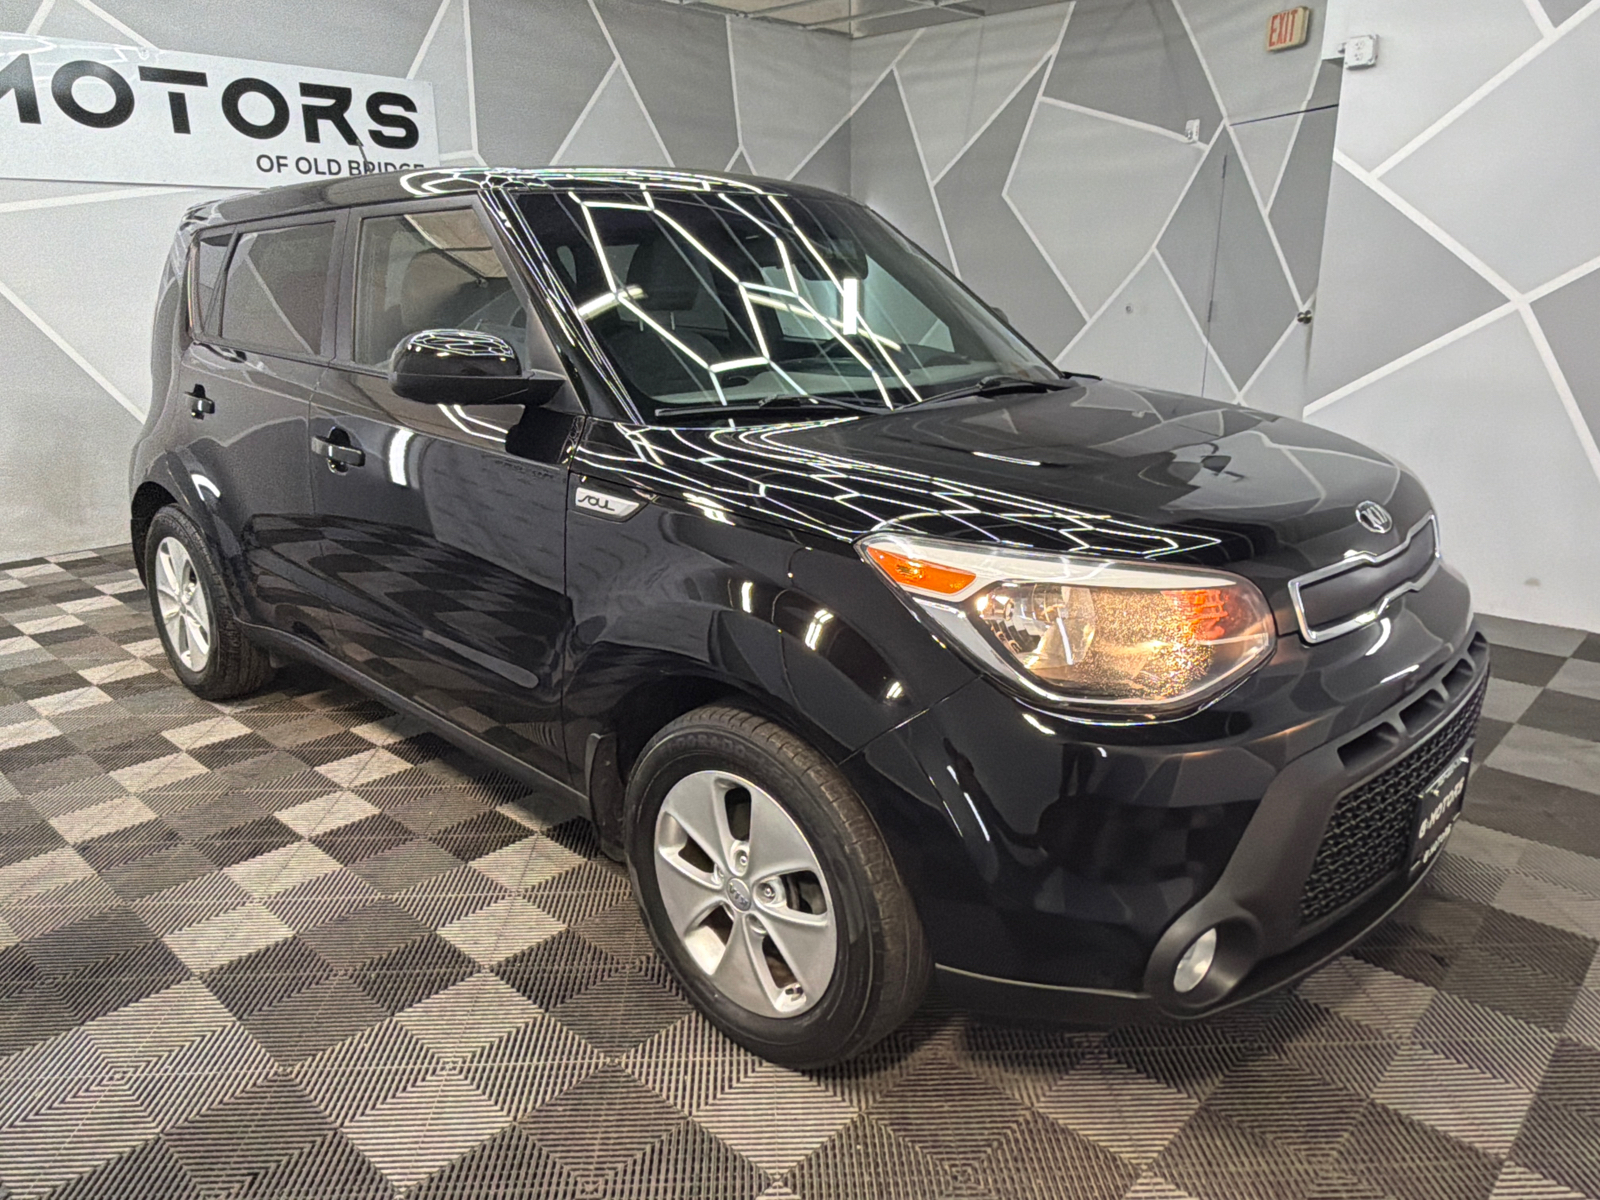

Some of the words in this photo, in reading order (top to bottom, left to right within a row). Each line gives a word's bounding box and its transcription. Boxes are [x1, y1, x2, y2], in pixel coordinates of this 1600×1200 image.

[1268, 9, 1298, 48] EXIT
[256, 154, 288, 173] OF
[295, 157, 342, 176] OLD
[348, 159, 425, 176] BRID
